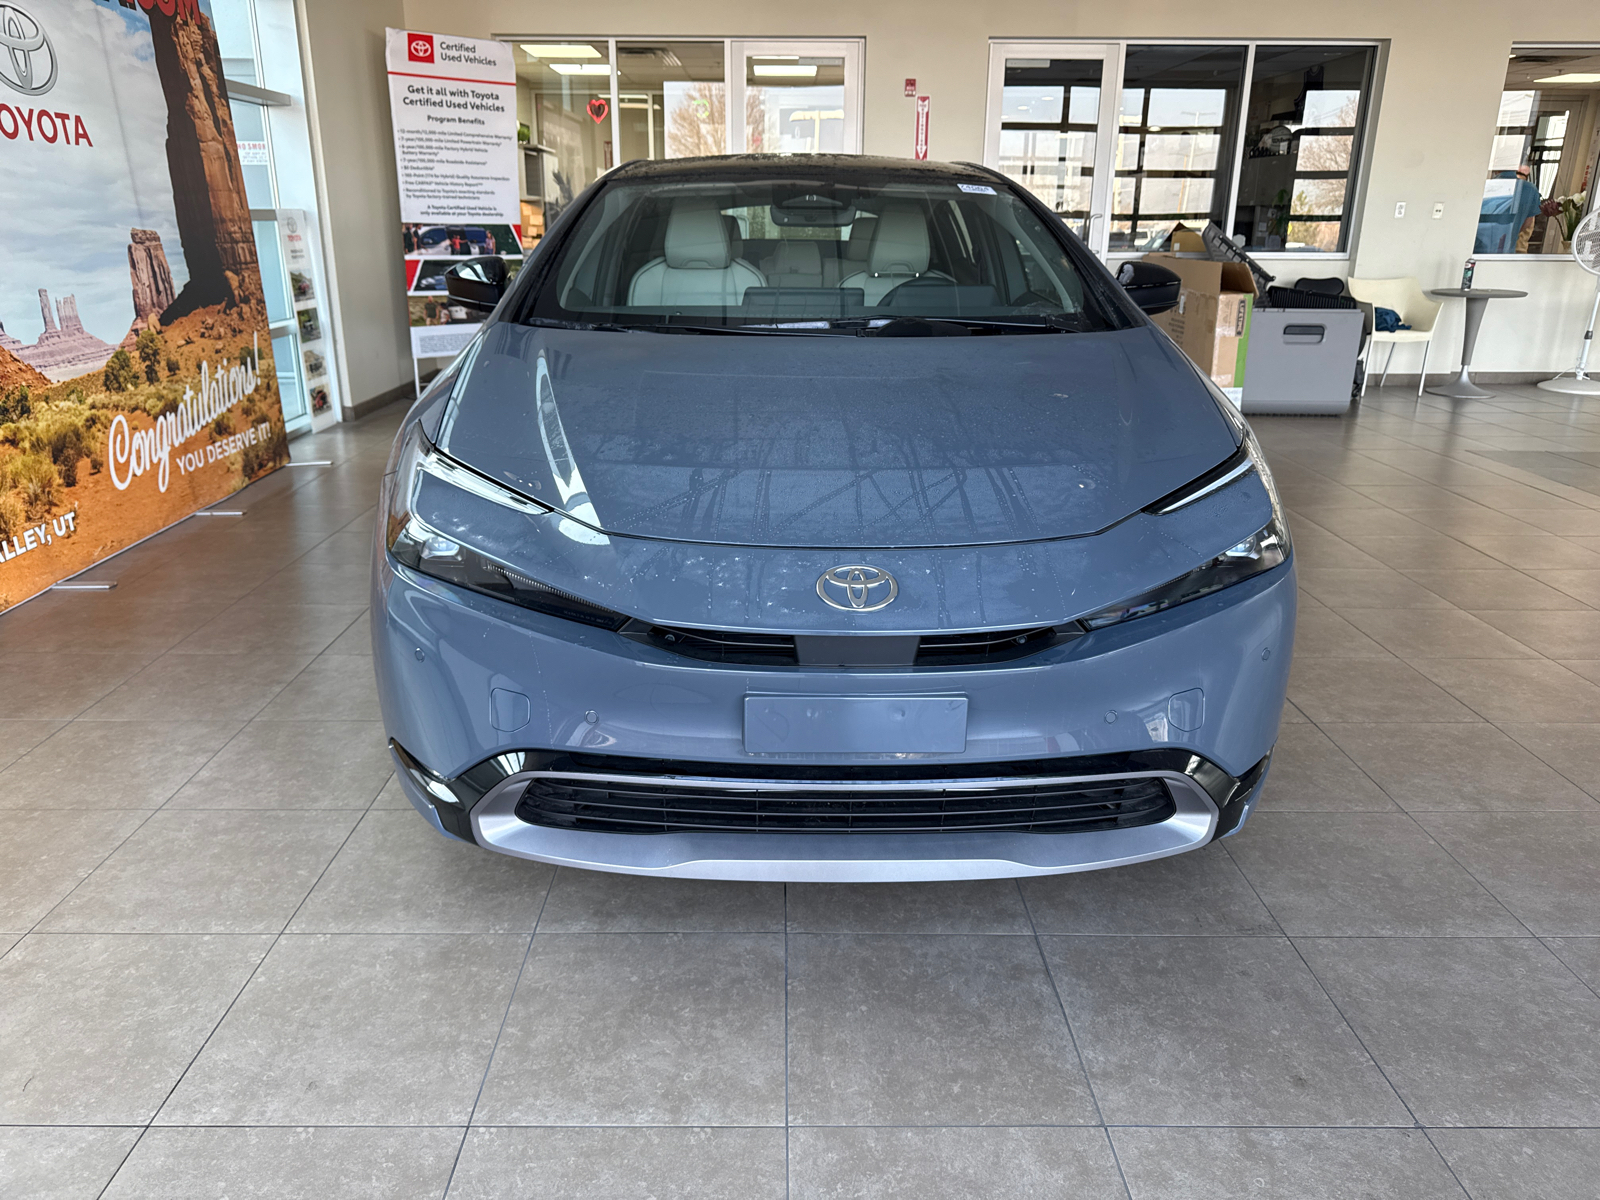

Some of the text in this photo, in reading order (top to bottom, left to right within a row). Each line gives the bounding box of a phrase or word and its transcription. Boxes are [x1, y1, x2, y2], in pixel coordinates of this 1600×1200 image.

[440, 42, 476, 53] Certified
[440, 52, 497, 66] Used Vehicles
[407, 84, 500, 102] Get it all with Toyota
[402, 96, 505, 112] Certified Used Vehicles
[426, 114, 486, 126] Program Benefits
[108, 330, 261, 493] Congratulations!
[176, 421, 272, 475] YOU DESERVE IT!
[52, 511, 75, 537] UT
